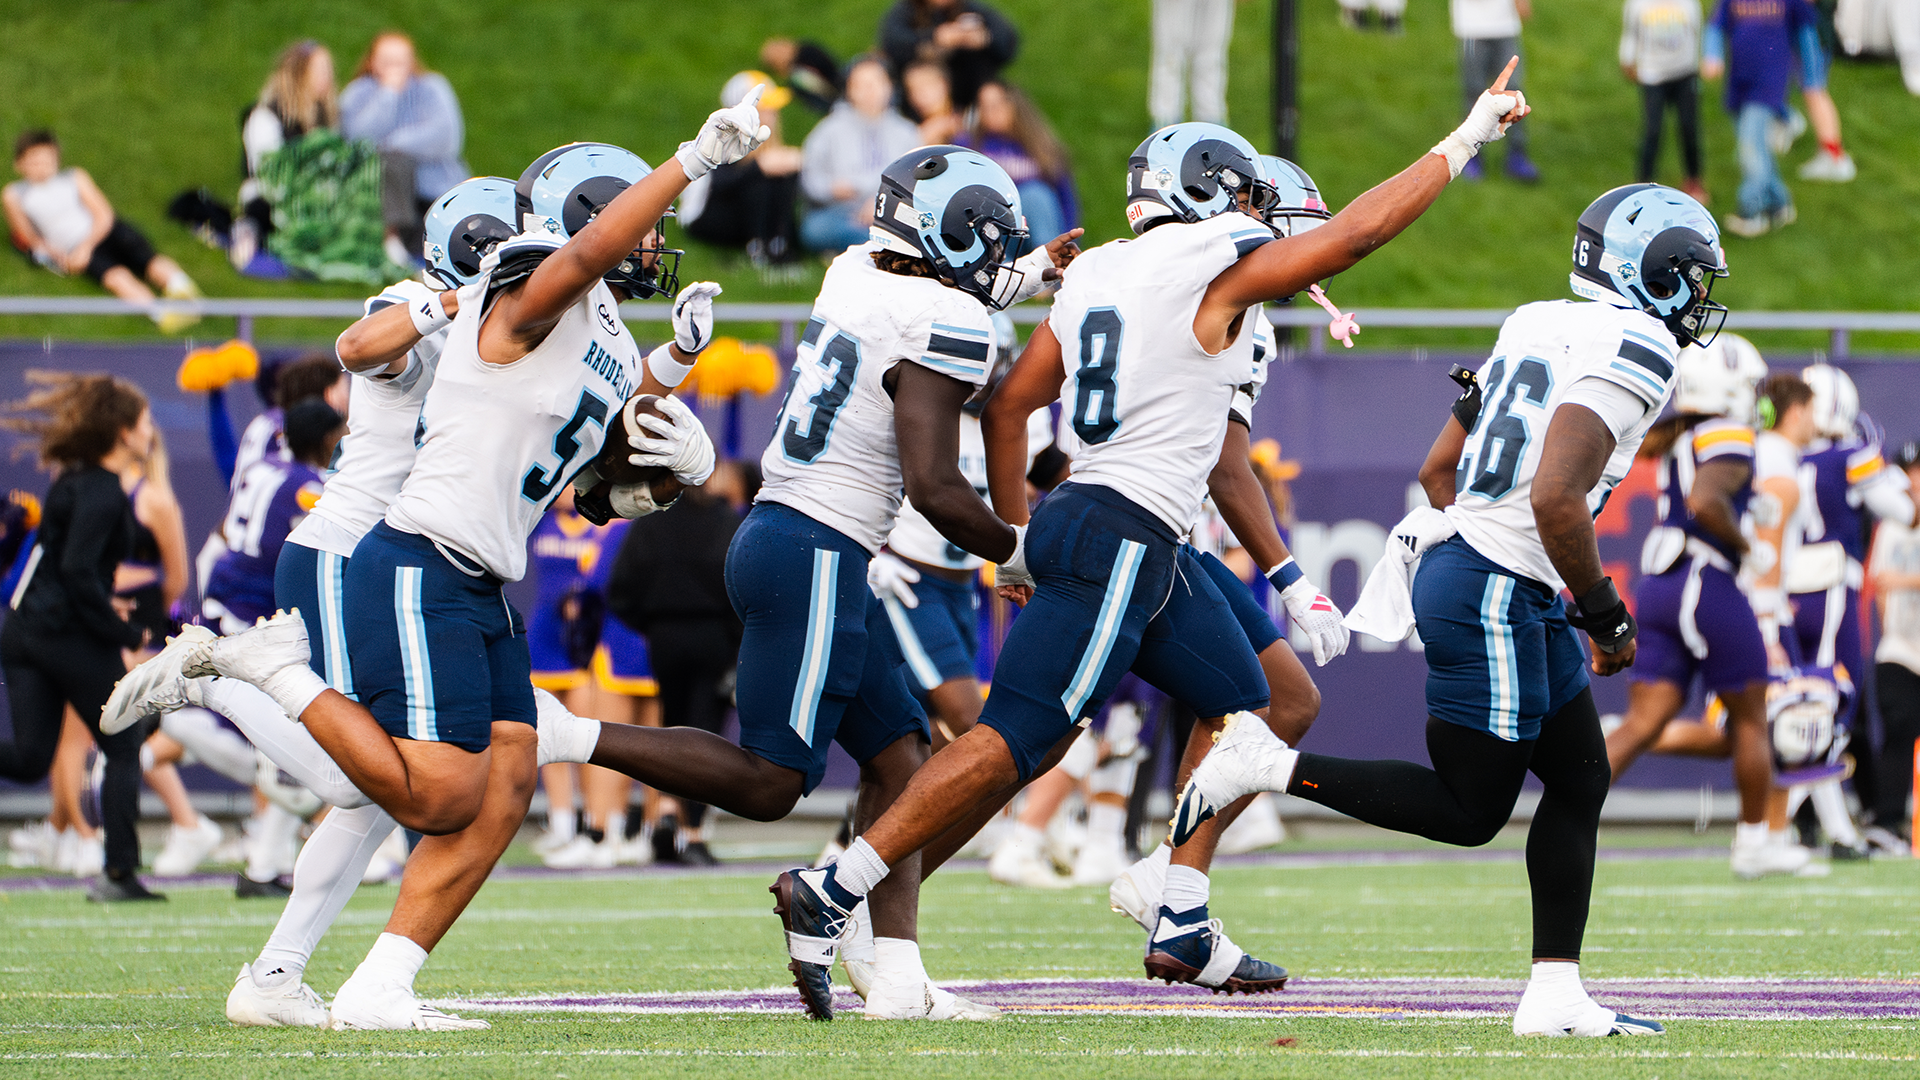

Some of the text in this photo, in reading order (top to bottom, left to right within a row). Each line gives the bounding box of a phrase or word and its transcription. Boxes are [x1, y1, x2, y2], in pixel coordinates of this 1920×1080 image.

[876, 193, 887, 218] 3
[1581, 287, 1601, 298] FEET
[1070, 305, 1125, 445] 8
[520, 385, 616, 512] 5
